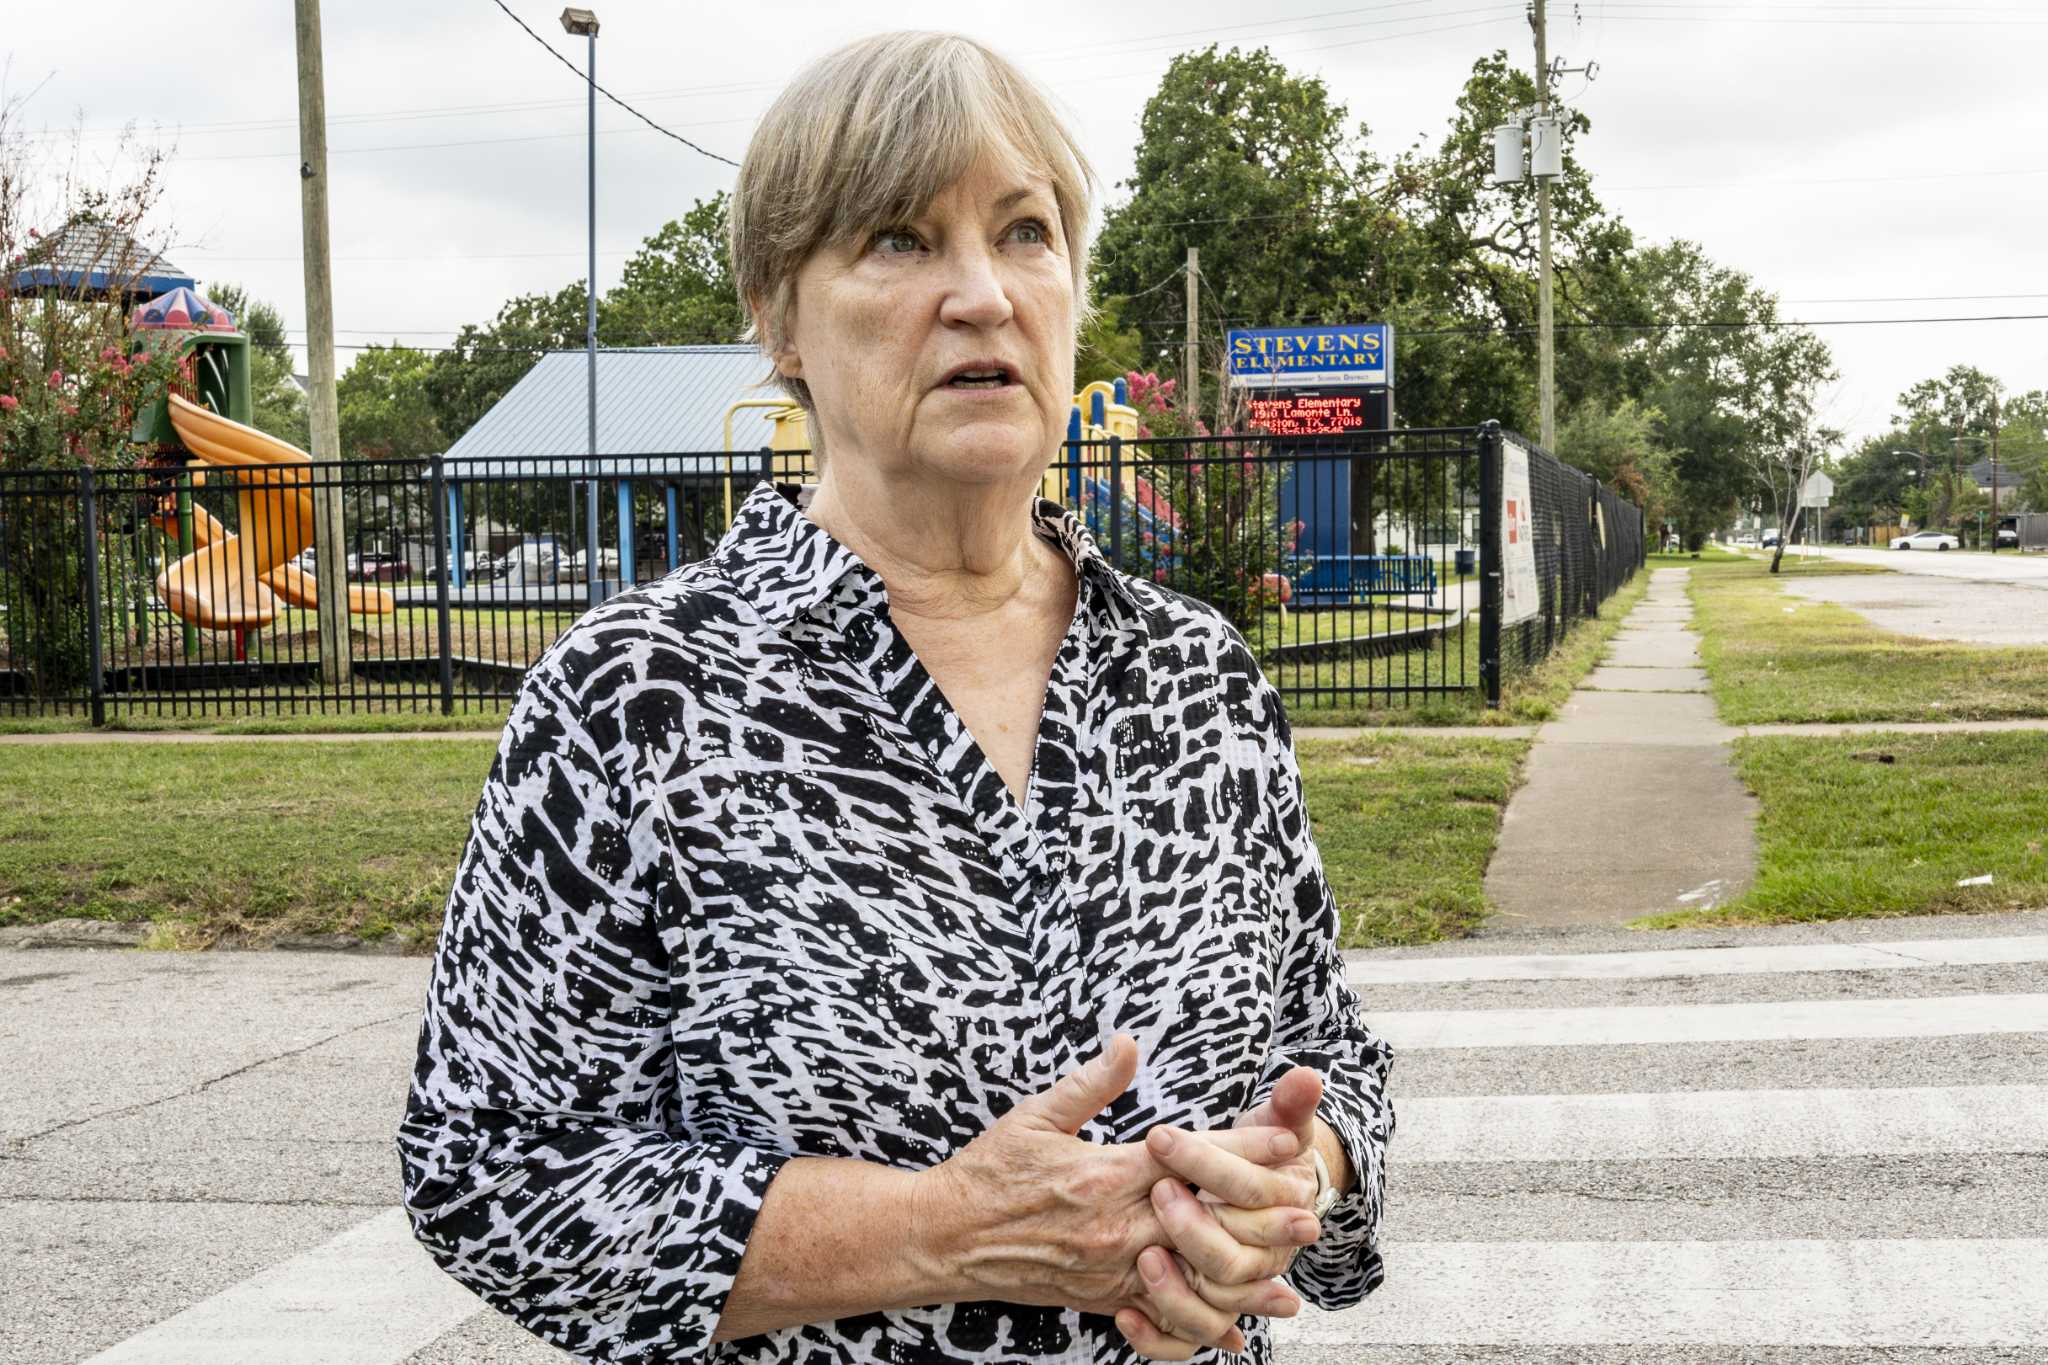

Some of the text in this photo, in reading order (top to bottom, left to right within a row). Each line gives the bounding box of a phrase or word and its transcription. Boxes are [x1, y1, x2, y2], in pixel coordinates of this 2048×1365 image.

[1234, 333, 1381, 354] STEVENS
[1236, 352, 1380, 369] ELEMENTARY
[1298, 397, 1361, 409] Elementary
[1283, 407, 1331, 418] Lamonte
[1336, 407, 1353, 417] Ln.
[1330, 416, 1363, 427] 77018
